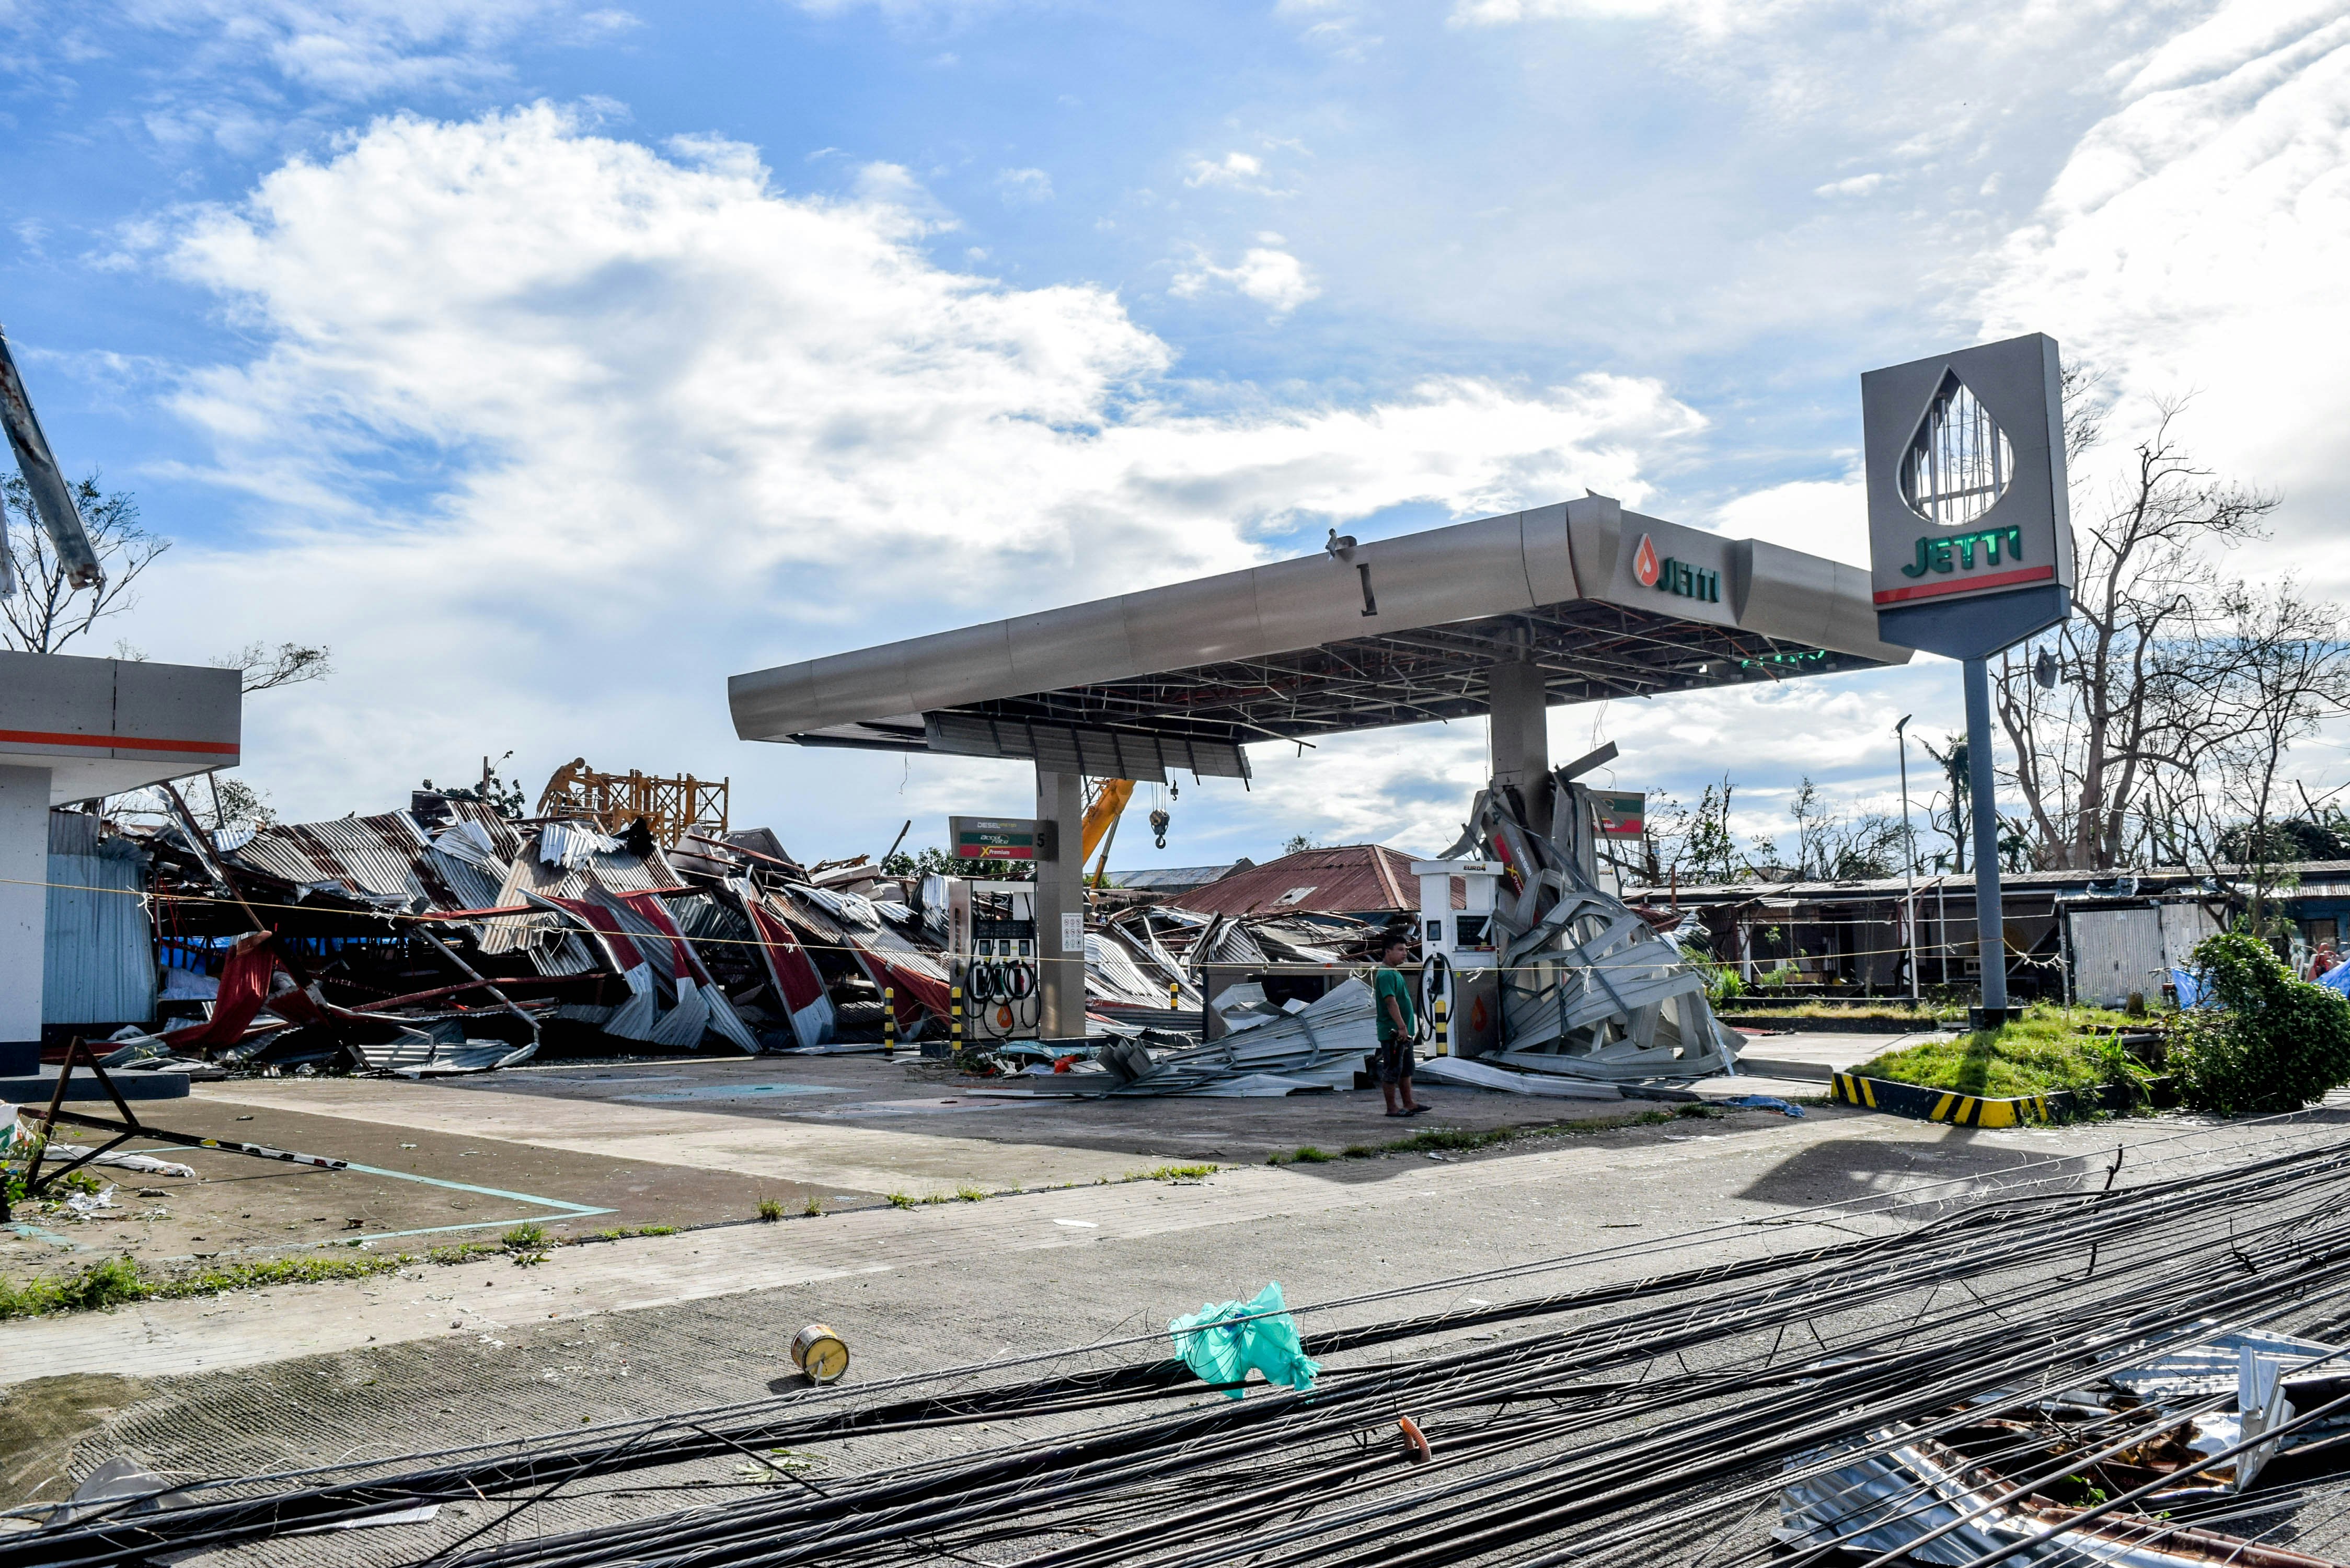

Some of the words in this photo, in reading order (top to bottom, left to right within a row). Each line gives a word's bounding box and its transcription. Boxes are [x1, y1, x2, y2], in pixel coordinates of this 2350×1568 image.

[1900, 525, 2021, 578] JETTI
[1657, 557, 1720, 603] JETTI
[1037, 833, 1045, 847] 5
[1516, 846, 1532, 878] DIESEL
